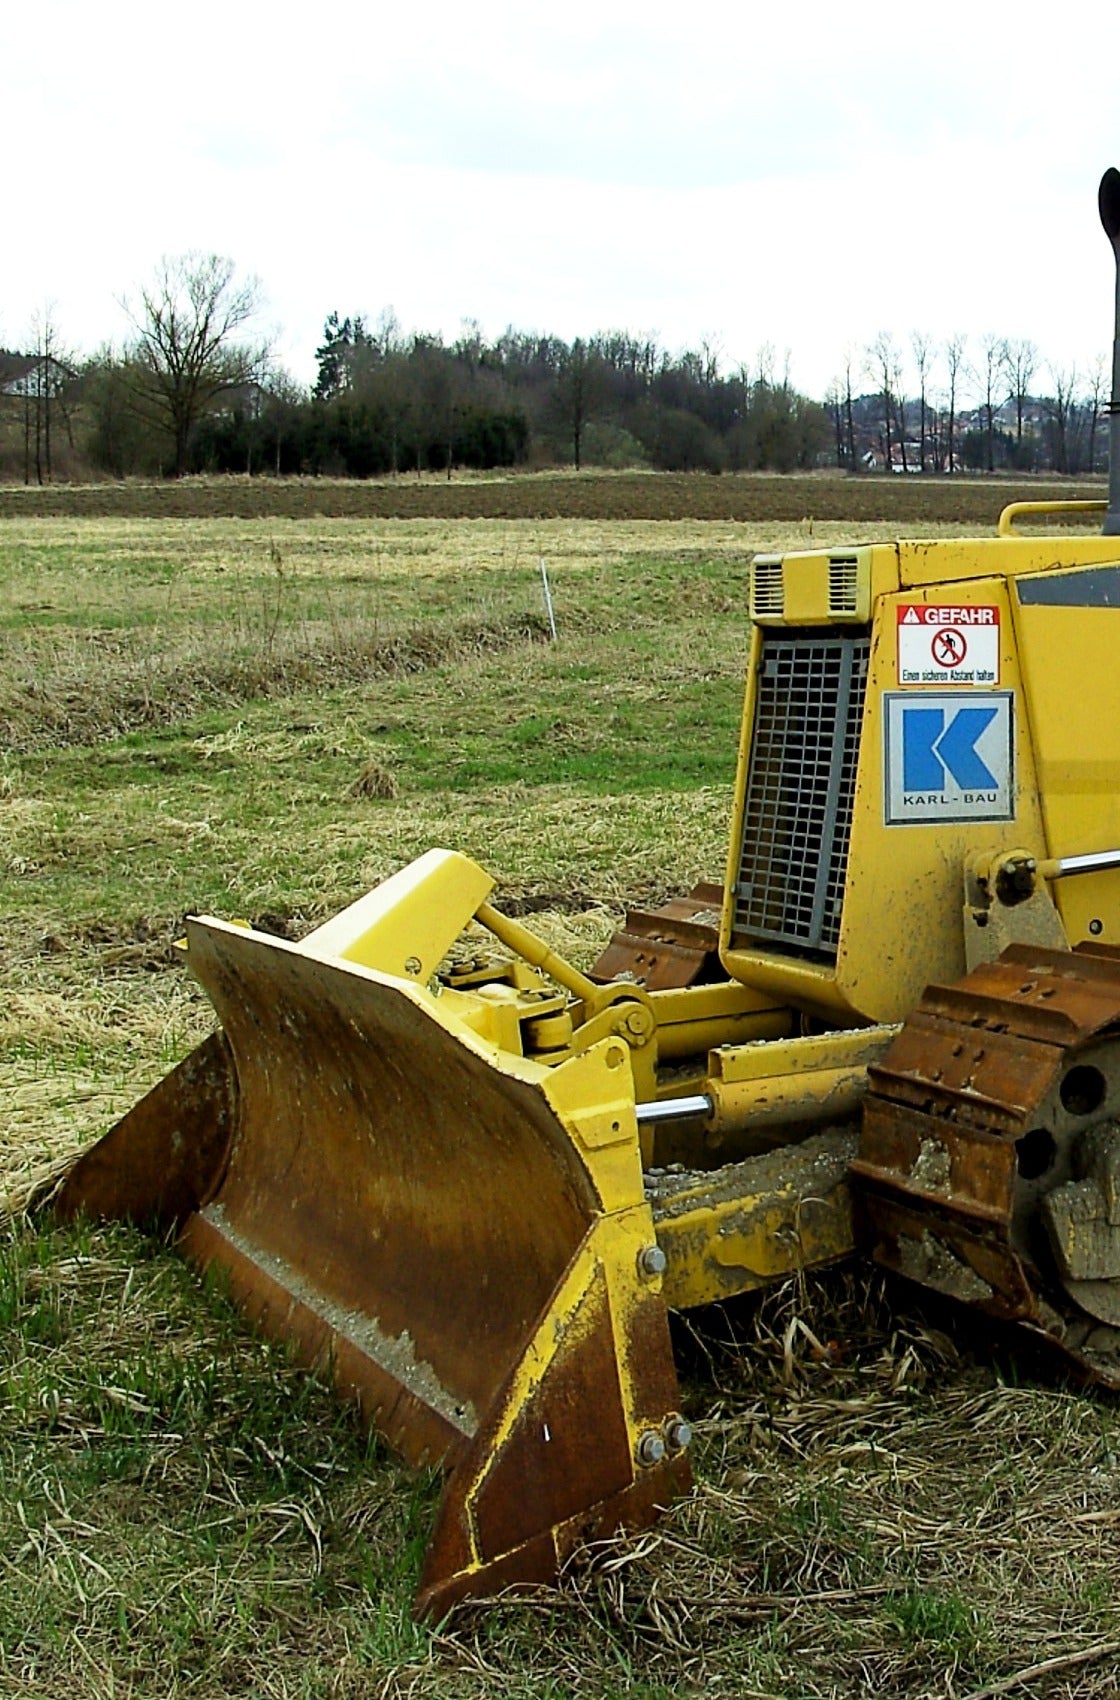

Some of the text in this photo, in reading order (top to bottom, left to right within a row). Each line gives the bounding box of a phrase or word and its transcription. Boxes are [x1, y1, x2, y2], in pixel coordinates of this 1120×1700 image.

[924, 608, 994, 624] GEFAHR
[902, 669, 995, 681] Einen sicheren Abstand halten
